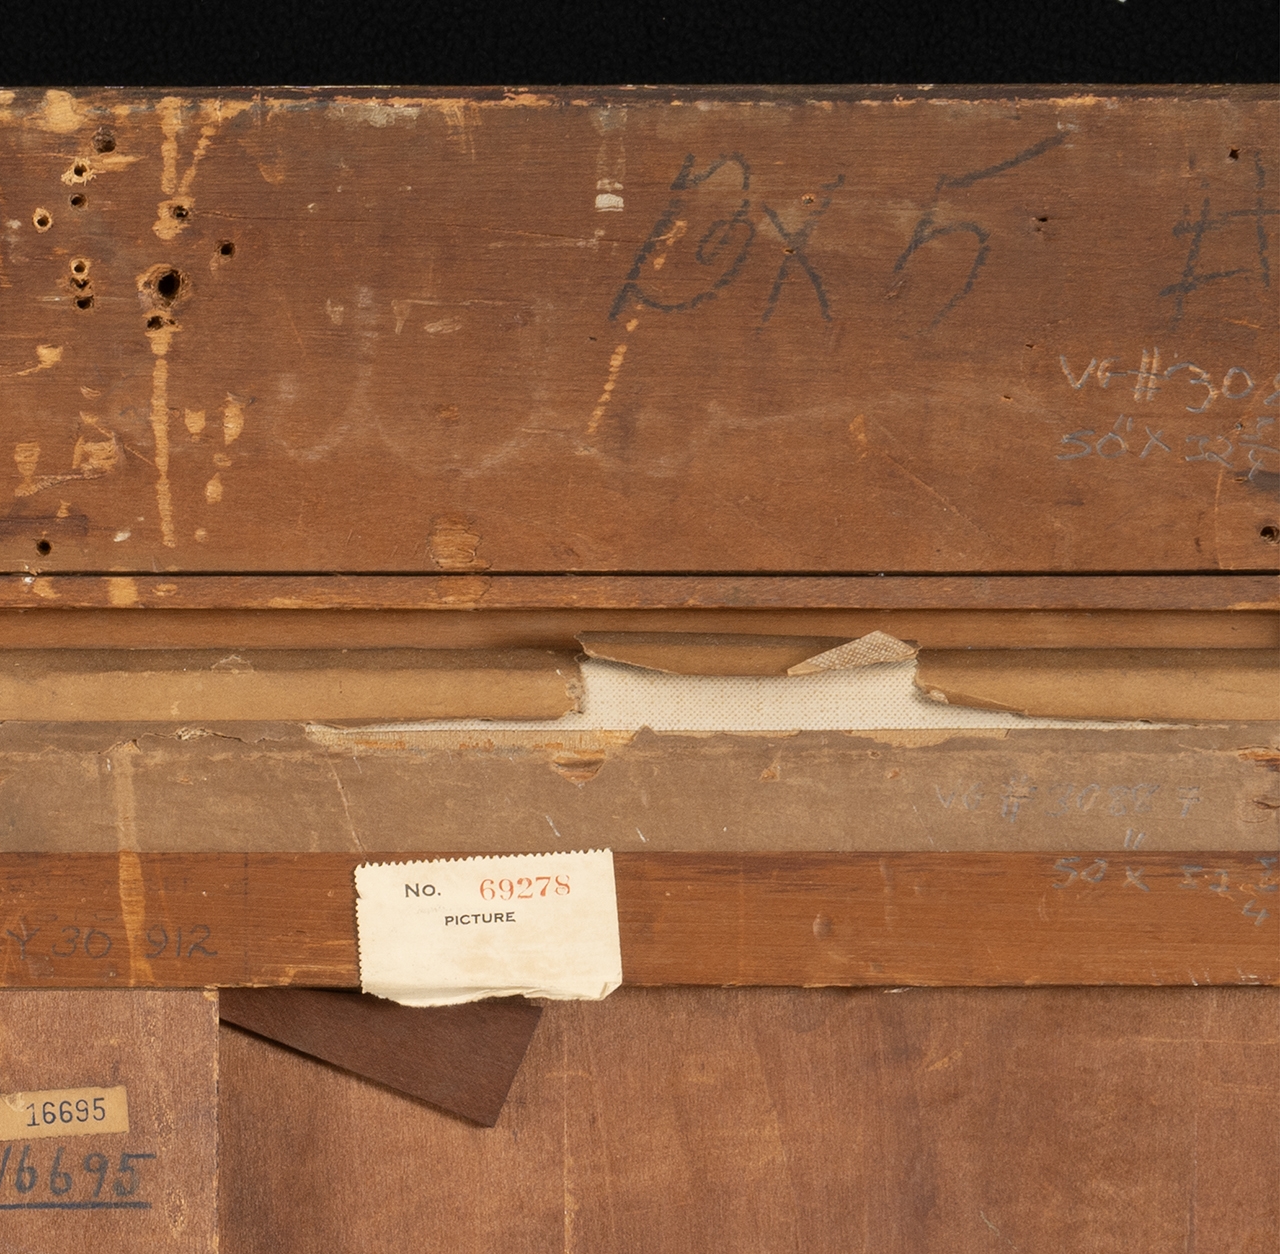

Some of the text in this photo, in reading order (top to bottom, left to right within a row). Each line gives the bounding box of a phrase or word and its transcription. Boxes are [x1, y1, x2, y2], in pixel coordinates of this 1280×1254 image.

[479, 874, 572, 902] 69278
[444, 911, 517, 926] PICTURE
[25, 1096, 107, 1128] 16695
